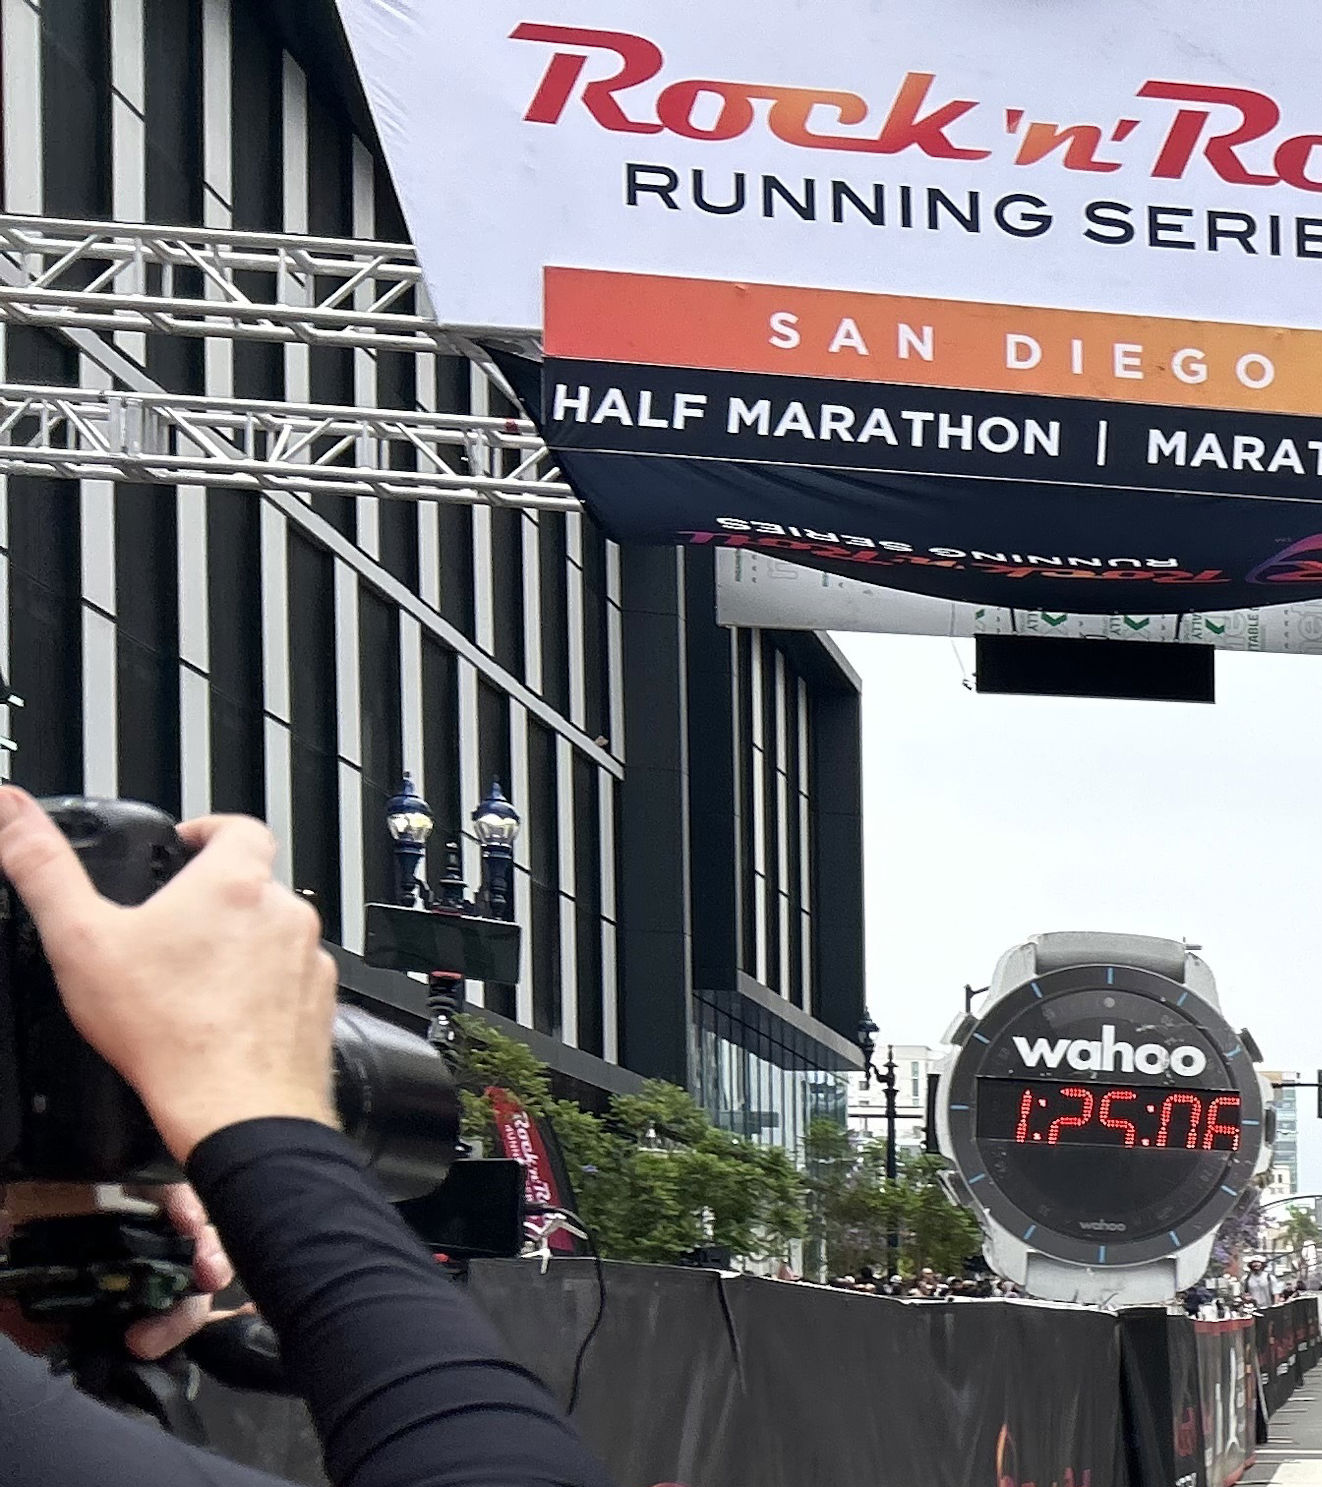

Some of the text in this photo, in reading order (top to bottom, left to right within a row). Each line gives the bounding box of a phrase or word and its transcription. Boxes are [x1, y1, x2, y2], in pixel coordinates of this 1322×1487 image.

[625, 162, 1054, 239] RUNNING
[768, 310, 1276, 390] SAN DIEGO
[552, 382, 708, 431] HALF
[725, 396, 1061, 458] MARATHON
[715, 516, 1180, 569] RUNNING SERIES
[1012, 1024, 1207, 1077] wahoo
[1079, 1218, 1127, 1232] wahoo
